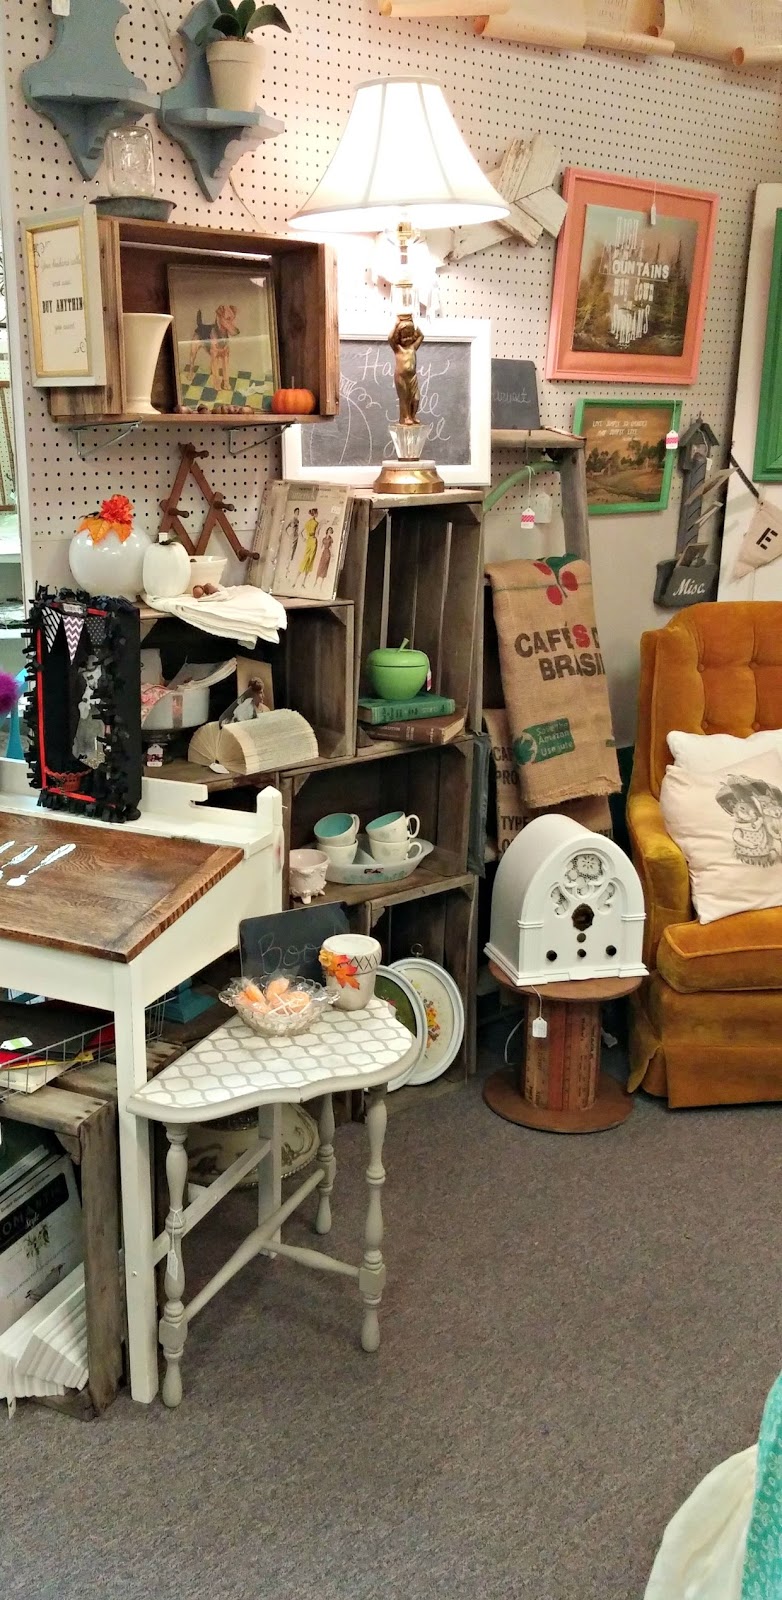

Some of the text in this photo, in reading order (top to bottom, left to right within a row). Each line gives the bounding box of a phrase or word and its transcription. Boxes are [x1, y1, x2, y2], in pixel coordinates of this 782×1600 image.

[42, 300, 53, 313] BUY
[354, 346, 450, 397] Hay
[756, 527, 779, 551] E
[673, 578, 706, 597] Misc.
